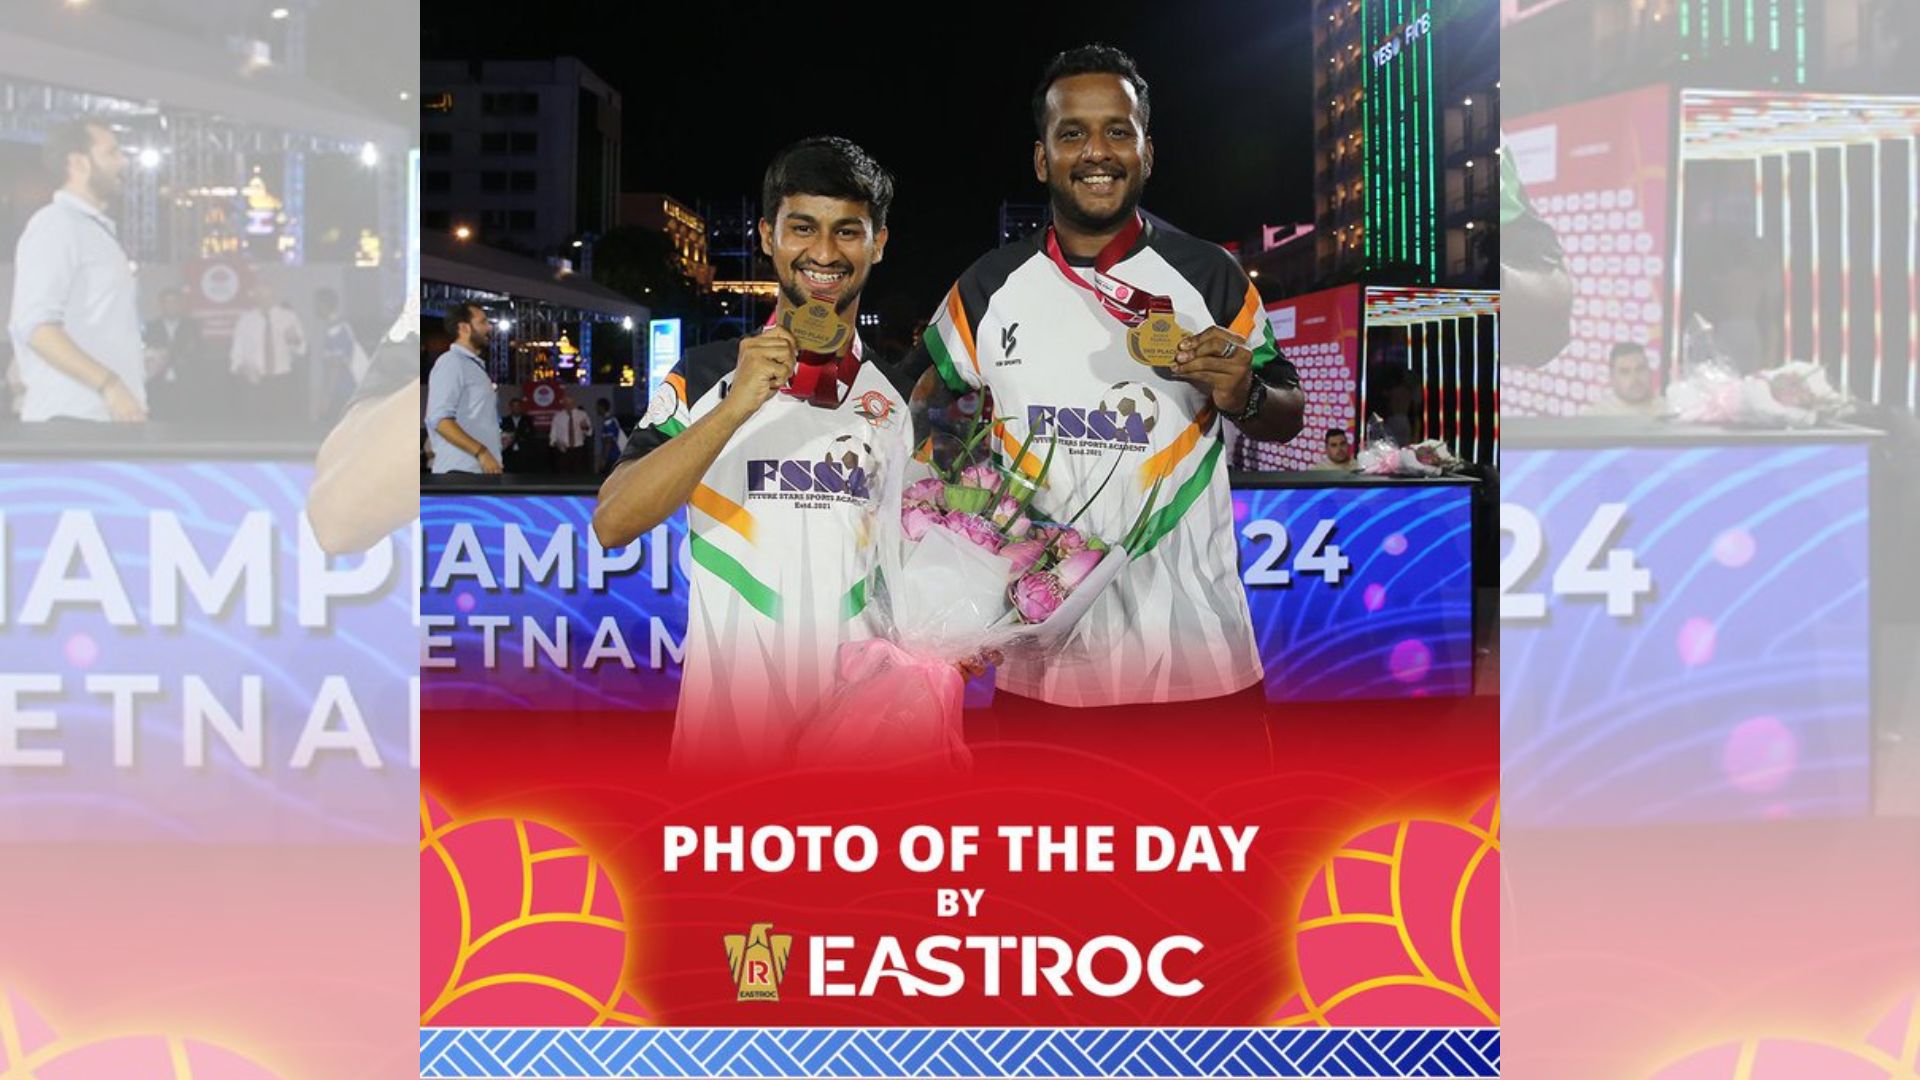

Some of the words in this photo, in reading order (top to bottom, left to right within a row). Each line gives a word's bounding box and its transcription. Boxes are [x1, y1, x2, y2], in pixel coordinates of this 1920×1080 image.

[1157, 347, 1177, 355] PLAC
[1027, 404, 1150, 444] FSSA
[1079, 440, 1107, 448] SPORTS
[747, 459, 870, 499] FSSA
[806, 493, 834, 501] SPORTS
[0, 509, 420, 627] AMP
[420, 522, 690, 590] AMPI
[1241, 518, 1349, 585] 24
[1500, 503, 1651, 618] 24
